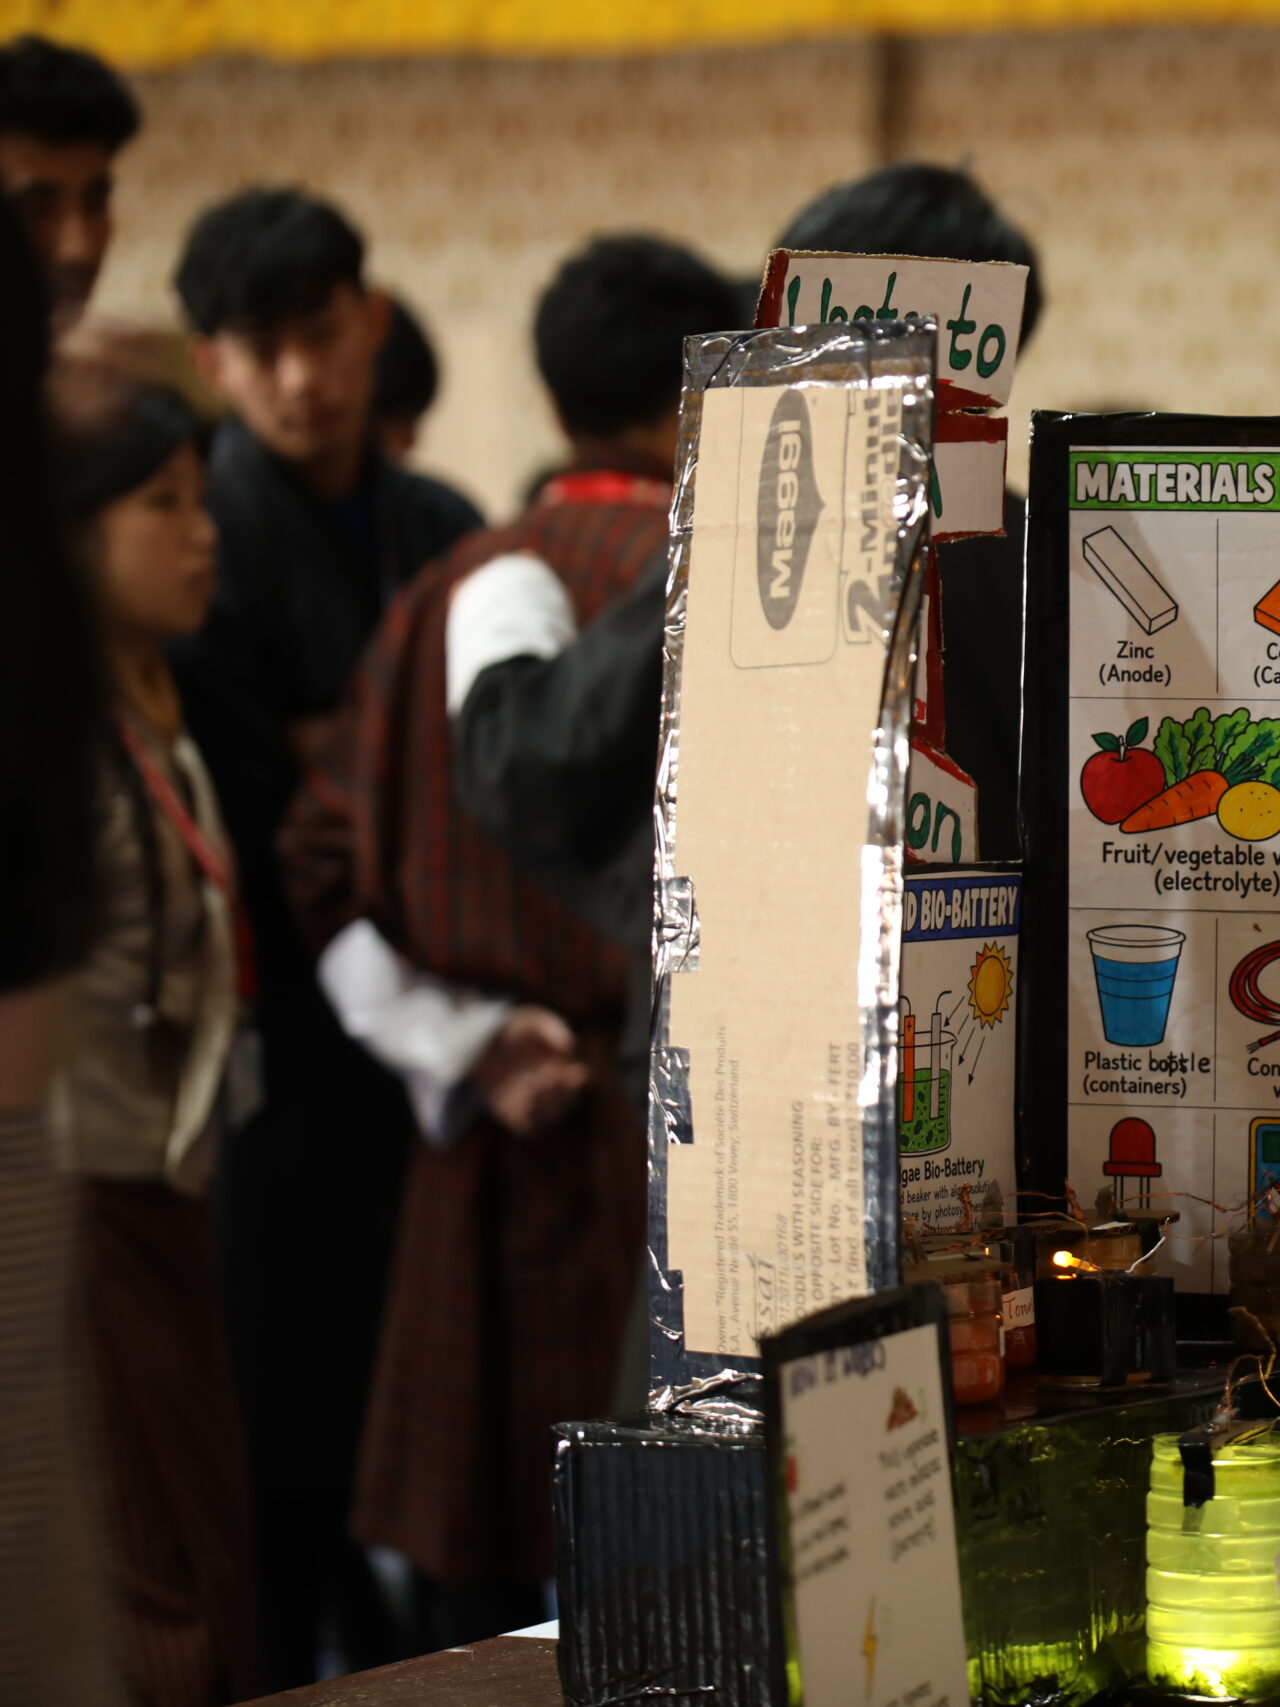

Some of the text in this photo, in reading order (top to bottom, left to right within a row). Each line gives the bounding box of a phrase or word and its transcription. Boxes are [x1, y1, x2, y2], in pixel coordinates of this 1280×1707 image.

[946, 283, 1006, 378] to
[1075, 461, 1275, 503] MATERIALS
[768, 419, 801, 598] Maggi
[1116, 640, 1154, 659] Zinc
[1099, 663, 1172, 687] (Anode)
[1102, 842, 1265, 871] Fruit/vegetable
[1154, 870, 1280, 897] (electrolyte)
[920, 886, 1018, 931] BIO-BATTERY
[715, 1025, 727, 1076] Produits
[828, 1041, 842, 1085] FERT
[1085, 1051, 1142, 1072] Plastic
[728, 1059, 740, 1131] Switzerland
[1082, 1074, 1187, 1098] (containers)
[828, 1103, 841, 1127] BY
[714, 1152, 725, 1164] of
[792, 1100, 805, 1198] SEASONING
[924, 1158, 984, 1179] Bio-Battery
[714, 1167, 726, 1231] Trademark
[811, 1179, 823, 1216] SIDE
[847, 1178, 860, 1200] all
[907, 1188, 932, 1205] beaker
[934, 1184, 949, 1200] with
[792, 1203, 805, 1247] WITH
[829, 1199, 842, 1230] No.
[846, 1205, 859, 1225] of
[922, 1206, 932, 1223] by
[811, 1222, 824, 1301] OPPOSITE
[829, 1236, 842, 1264] Lot
